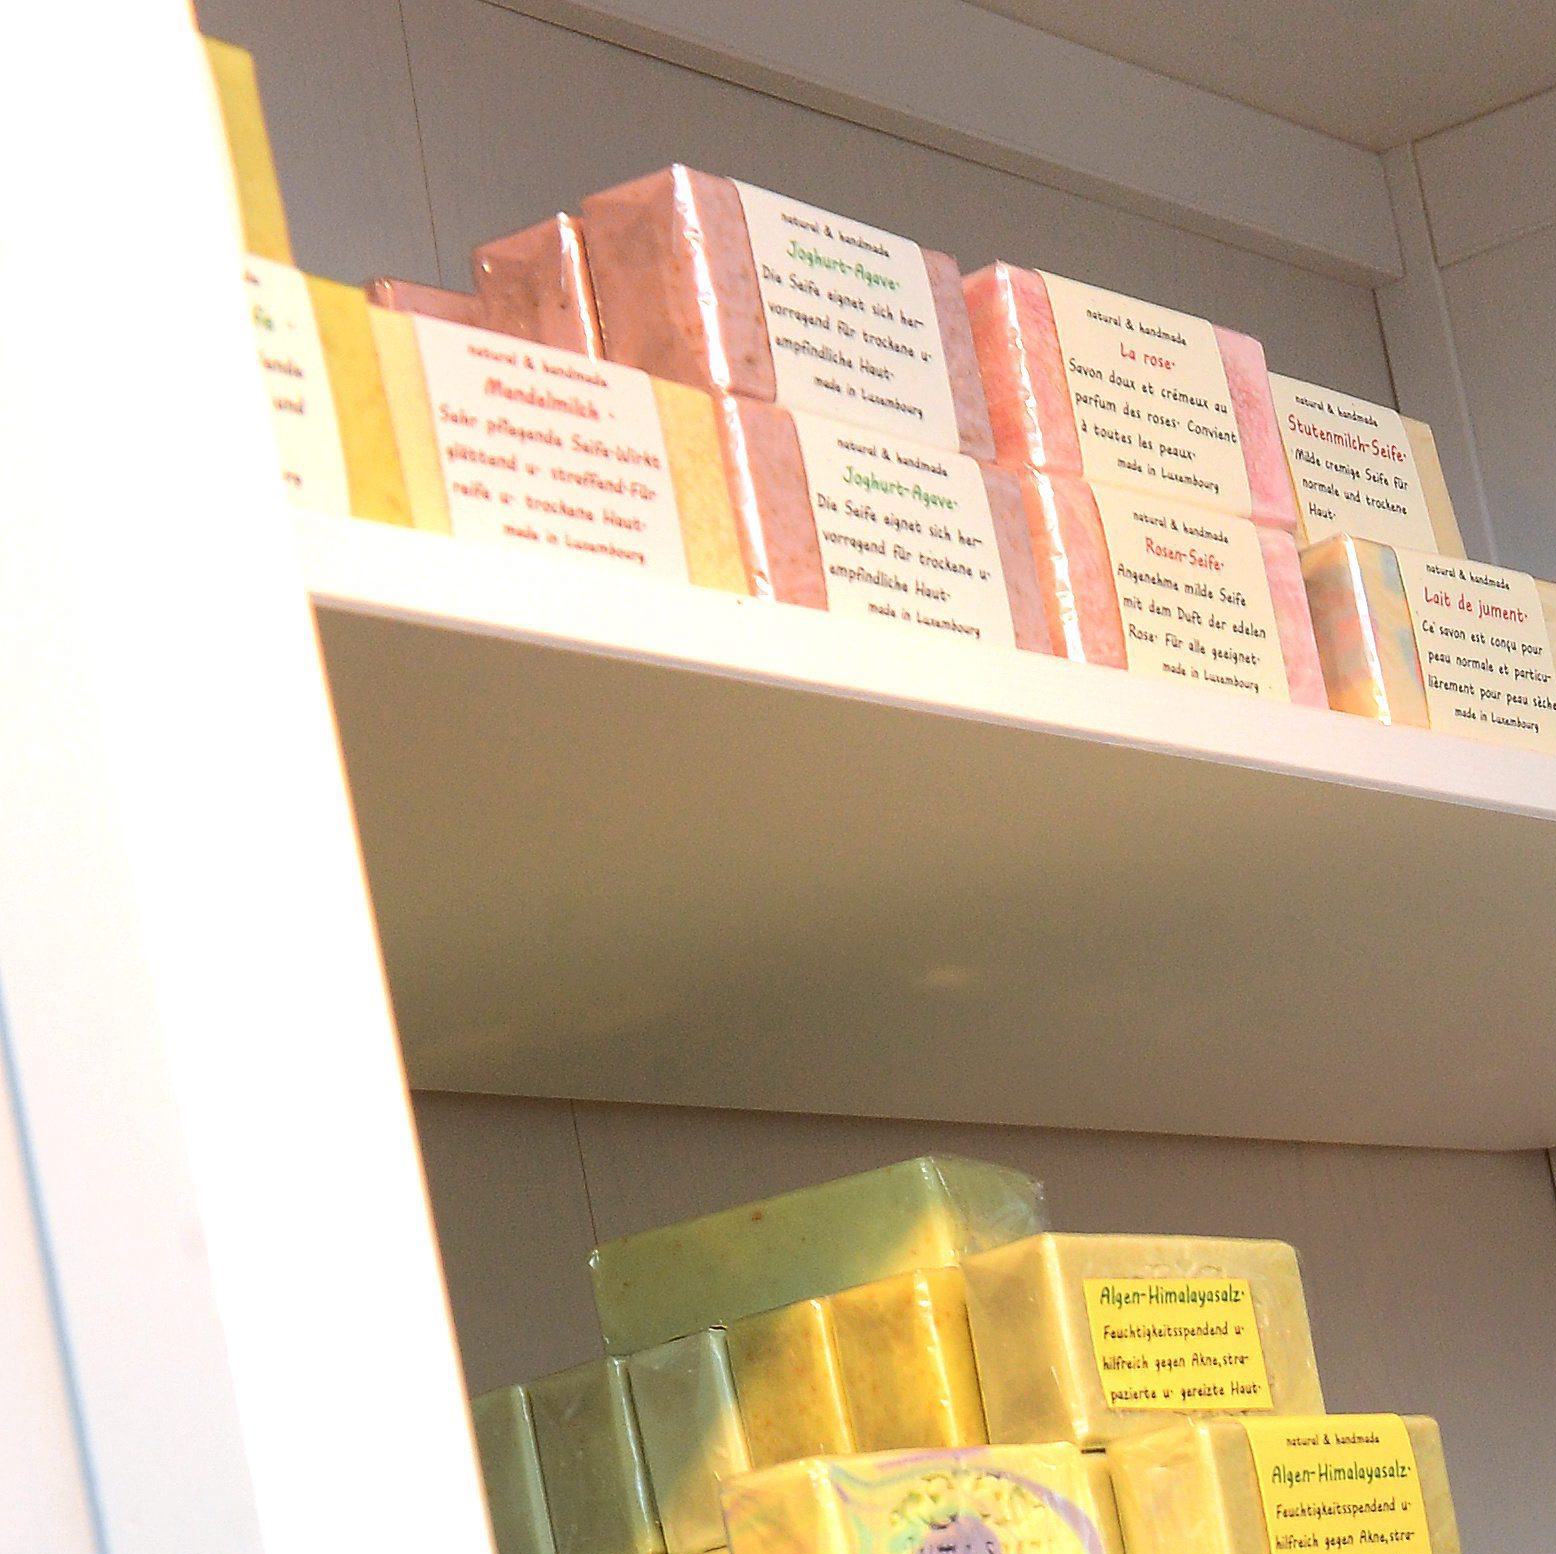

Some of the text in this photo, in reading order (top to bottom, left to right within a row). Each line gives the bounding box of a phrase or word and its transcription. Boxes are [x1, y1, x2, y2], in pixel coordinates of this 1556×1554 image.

[1086, 309, 1186, 346] natural & handmade
[1120, 341, 1136, 361] La
[1068, 357, 1227, 414] Savon doux et crémeux au
[1074, 391, 1116, 412] parfum
[1122, 401, 1141, 419] des
[1186, 419, 1235, 444] Convient
[1080, 418, 1087, 433] à
[1093, 423, 1132, 444] toutes
[1137, 433, 1153, 450] les
[1117, 458, 1219, 494] made in Luxembourg
[1294, 448, 1407, 490] Milde cremige Seife für
[1302, 478, 1407, 515] normale und trockene
[1424, 586, 1450, 607] Lait
[1457, 592, 1472, 612] de
[1103, 1320, 1228, 1342] Feuchtigkeitsspendend
[1102, 1354, 1148, 1370] hilfreich
[1154, 1357, 1185, 1372] gegen
[1110, 1386, 1156, 1405] pazierte
[1180, 1382, 1224, 1406] gereizte
